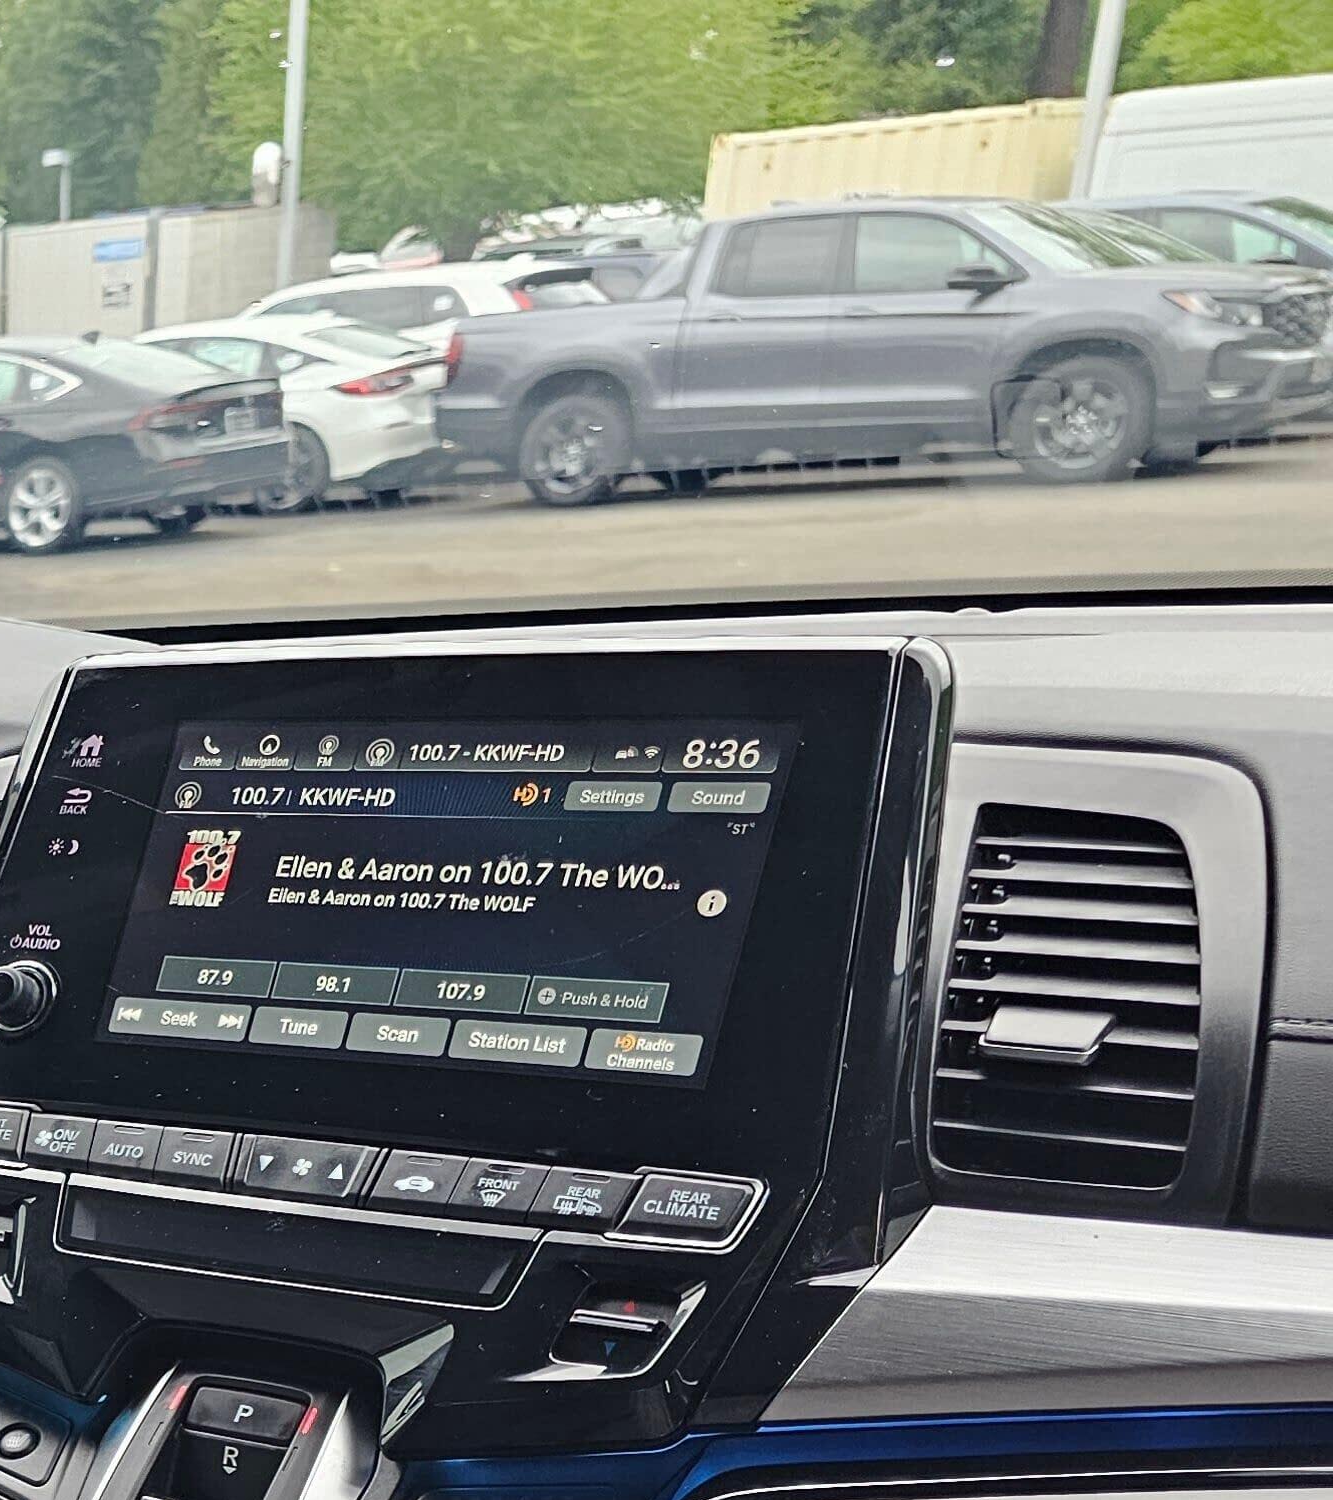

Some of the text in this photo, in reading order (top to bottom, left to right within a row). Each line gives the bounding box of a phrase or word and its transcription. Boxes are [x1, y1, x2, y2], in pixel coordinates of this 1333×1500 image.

[193, 757, 222, 767] Phone
[316, 757, 332, 767] FM
[409, 744, 461, 762] 100.7
[473, 744, 565, 763] KKWF-HD
[682, 739, 761, 769] 8:36
[70, 757, 102, 768] HOME
[241, 757, 289, 769] Navigation
[232, 787, 396, 807] 100.7 KKWF-HD
[542, 787, 552, 803] 1
[579, 789, 645, 806] Settings
[691, 789, 745, 806] Sound
[59, 805, 88, 815] BACK
[187, 830, 241, 845] 100.7
[276, 855, 332, 880] Ellen
[337, 858, 355, 880] &
[361, 858, 433, 883] Aaron
[439, 866, 471, 884] on
[480, 861, 553, 886] 100.7
[559, 864, 608, 888] The
[177, 891, 225, 907] WOLF
[268, 888, 536, 914] Ellen & Aaron on 100.7 The WOLF
[28, 924, 52, 936] VOL
[21, 937, 61, 950] AUDIO
[196, 968, 233, 986] 87.9
[315, 976, 351, 993] 98.1
[436, 983, 486, 1001] 107.9
[561, 992, 648, 1009] Push & Hold
[160, 1011, 198, 1028] Seek
[280, 1019, 318, 1036] Tune
[376, 1025, 418, 1043] Scan
[468, 1031, 566, 1055] Station List
[637, 1037, 675, 1053] Radio
[606, 1054, 675, 1072] Channels
[53, 1128, 80, 1143] ON/
[49, 1140, 77, 1154] OFF
[102, 1143, 144, 1159] AUTO
[172, 1151, 213, 1167] SYNC
[478, 1178, 520, 1190] FRONT
[567, 1186, 601, 1199] REAR
[669, 1189, 711, 1205] REAR
[643, 1200, 721, 1221] CLIMATE
[234, 1405, 253, 1423] P
[222, 1446, 238, 1467] R
